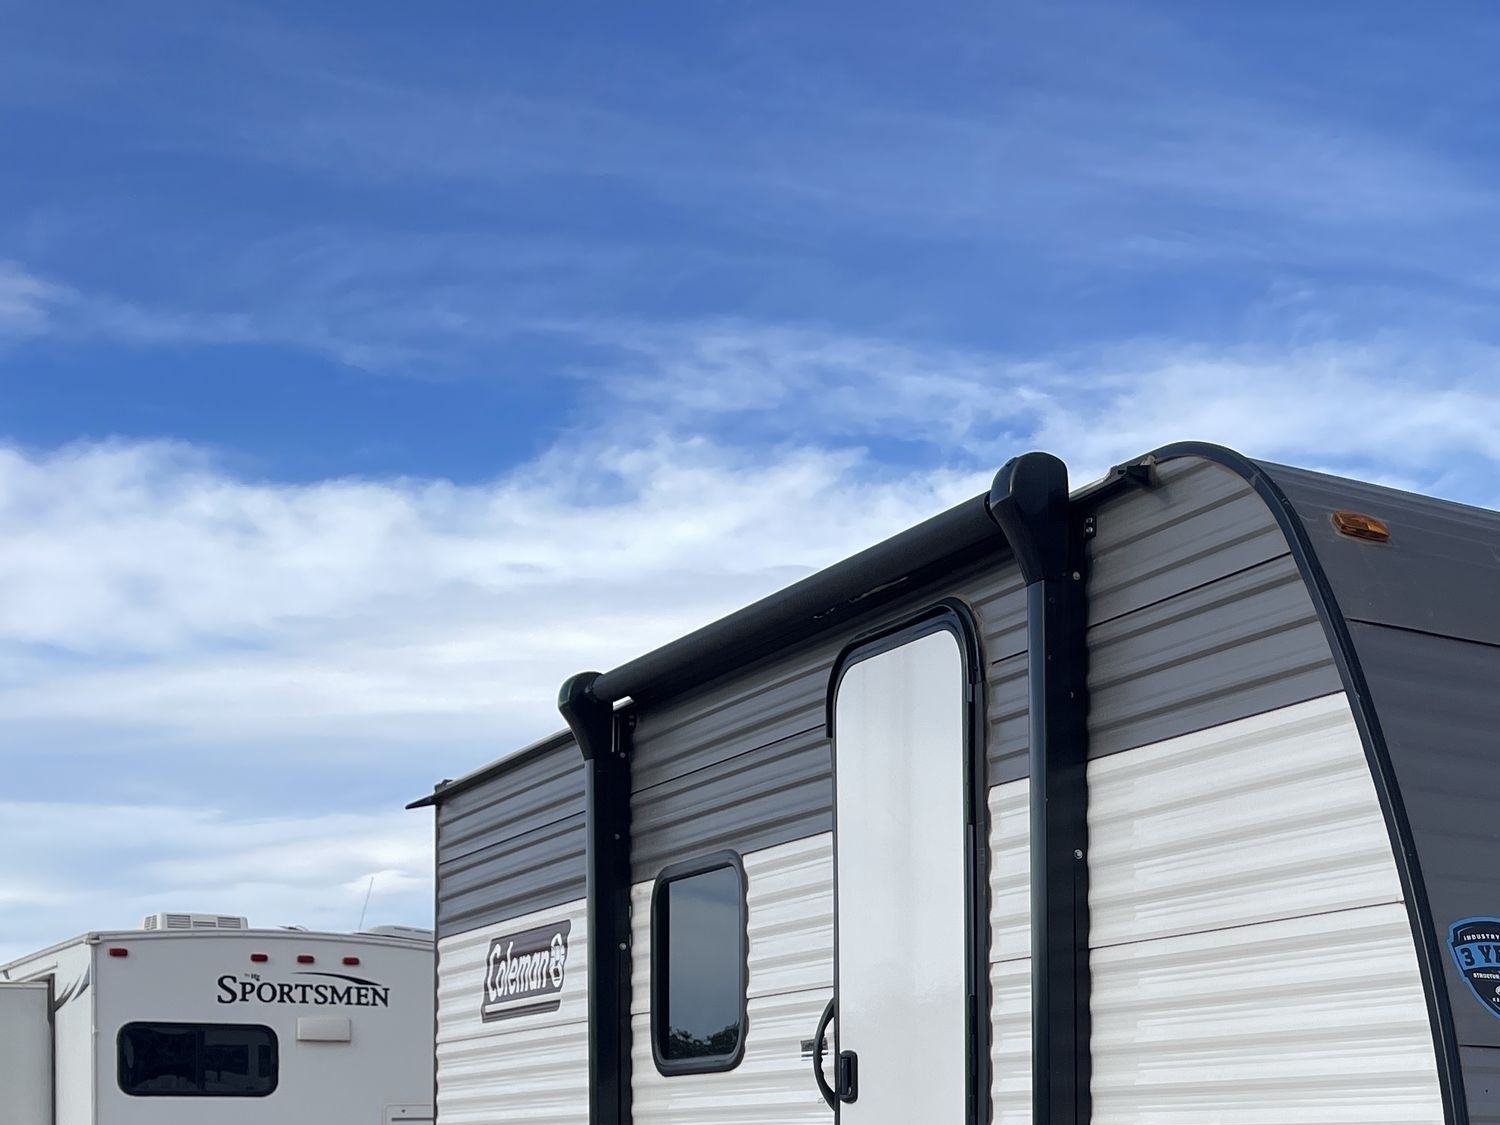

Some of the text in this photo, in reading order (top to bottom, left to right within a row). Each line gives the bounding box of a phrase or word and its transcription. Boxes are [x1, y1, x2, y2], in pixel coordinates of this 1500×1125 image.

[487, 941, 550, 1002] Coleman
[1460, 947, 1475, 966] 3
[217, 975, 390, 1008] SPORTSMEN
